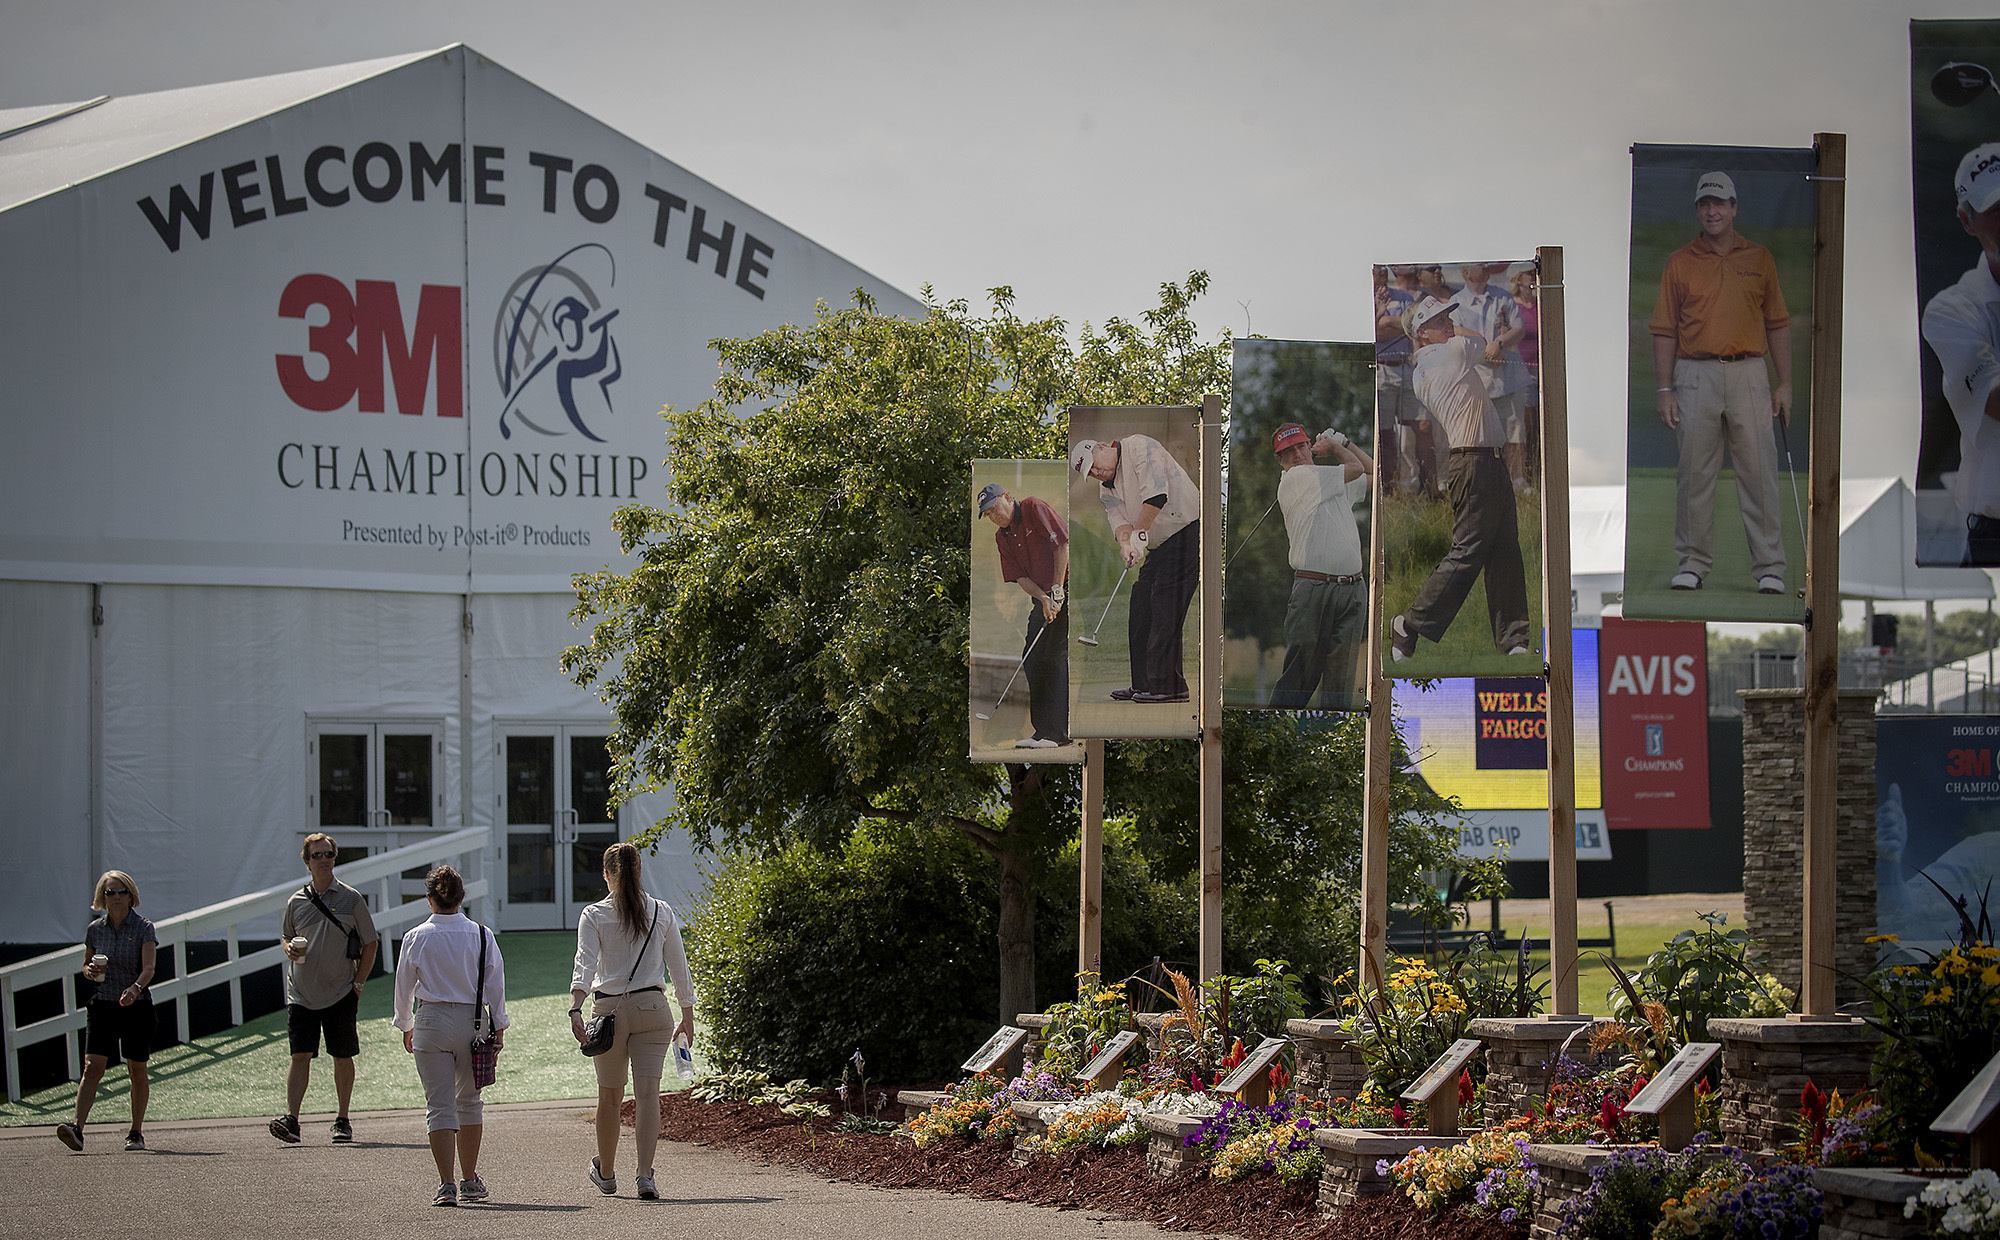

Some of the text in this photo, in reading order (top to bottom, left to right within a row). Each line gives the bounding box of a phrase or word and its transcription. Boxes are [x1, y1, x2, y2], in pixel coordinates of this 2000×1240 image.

[136, 141, 775, 301] WELCOME TO THE
[275, 272, 464, 419] 3M
[277, 442, 649, 499] CHAMPIONSHIP
[343, 519, 423, 546] Presented
[428, 524, 448, 551] by
[523, 524, 592, 547] Products
[1607, 655, 1696, 696] AVIS
[1478, 691, 1547, 713] WELLS
[1481, 718, 1548, 739] FARGO
[1953, 726, 2000, 736] HOME OF
[1946, 748, 1991, 777] 3M
[1488, 826, 1521, 847] CUP
